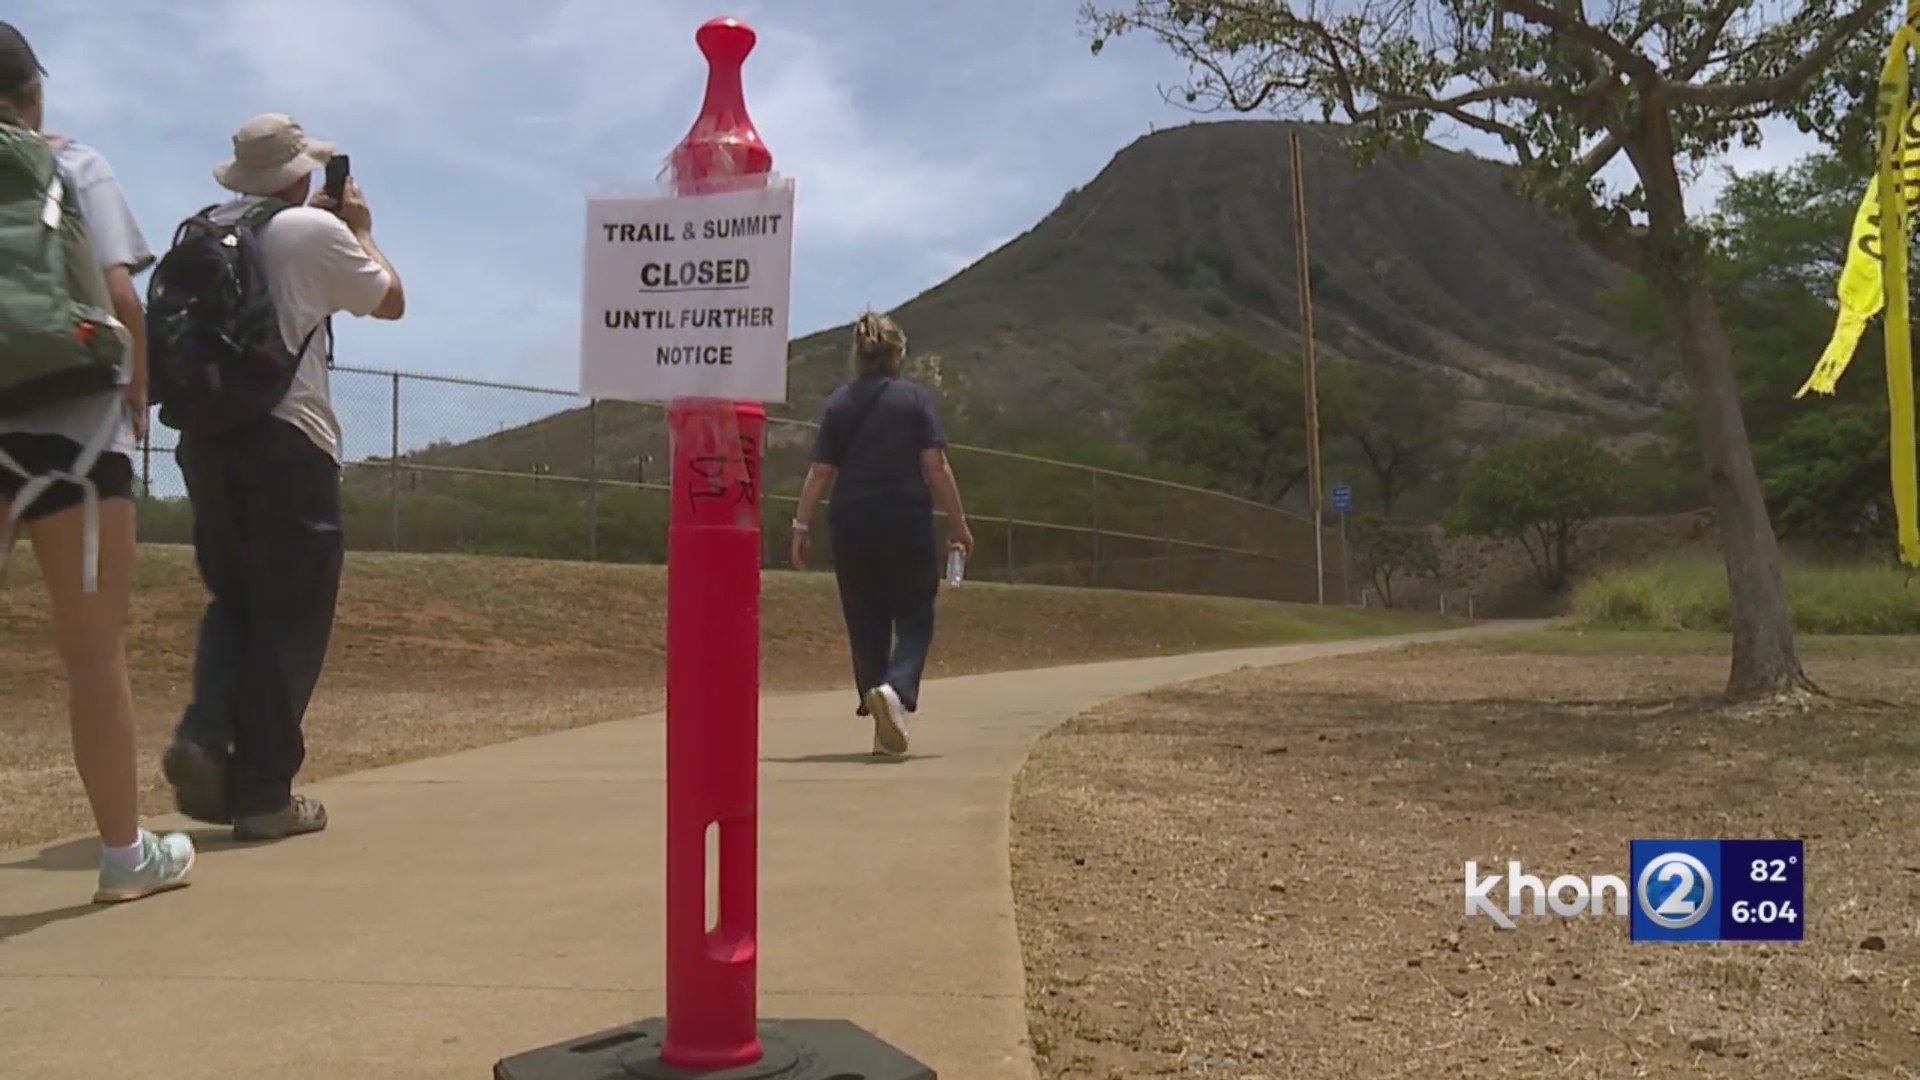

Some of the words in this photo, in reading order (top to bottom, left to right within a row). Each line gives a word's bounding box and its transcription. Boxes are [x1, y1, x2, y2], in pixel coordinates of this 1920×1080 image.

[603, 223, 675, 242] TRAIL
[682, 221, 696, 240] &
[703, 214, 782, 239] SUMMIT
[640, 258, 750, 287] CLOSED
[604, 309, 674, 329] UNTIL
[680, 306, 774, 328] FURTHER
[656, 346, 733, 366] NOTICE
